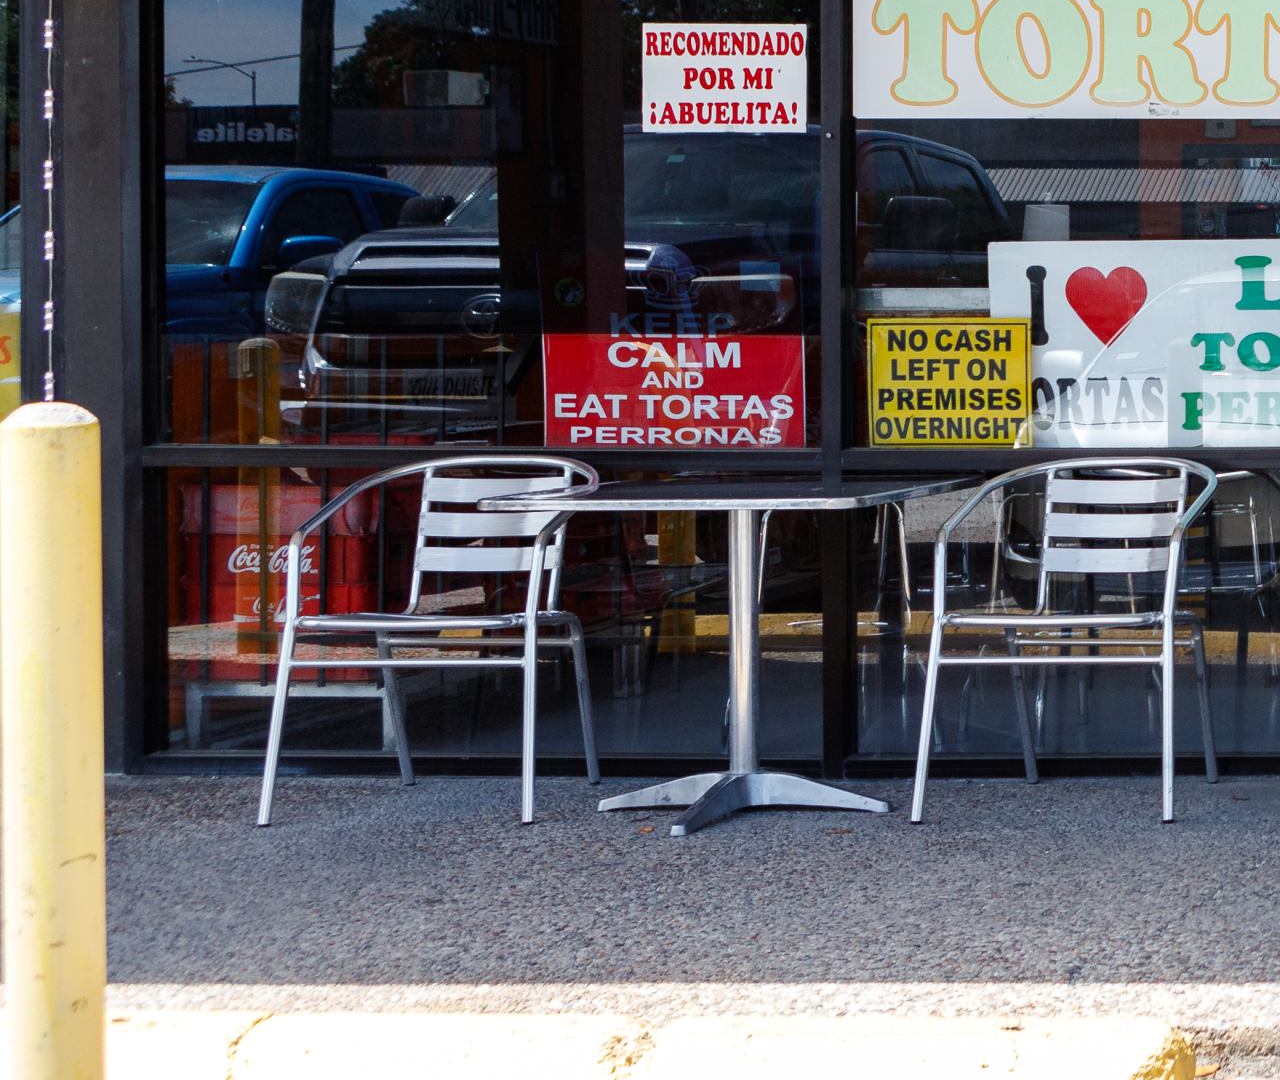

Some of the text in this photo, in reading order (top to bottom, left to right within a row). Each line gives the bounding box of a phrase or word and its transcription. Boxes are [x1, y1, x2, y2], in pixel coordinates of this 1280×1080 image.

[645, 31, 805, 57] RECOMENDADO
[683, 67, 774, 90] POR MI
[650, 102, 798, 125] ¡ABUELITA!
[1026, 265, 1048, 347] I
[610, 311, 737, 338] KEEP
[886, 330, 1012, 353] NO CASH
[607, 341, 741, 369] CALM
[641, 371, 704, 389] AND
[891, 358, 1007, 381] LEFT ON
[554, 394, 795, 420] EAT TORTAS
[877, 388, 1021, 411] PREMISES
[1032, 376, 1165, 432] ORTAS
[570, 426, 782, 445] PERRONAS
[875, 416, 1027, 440] OVERNIGHT
